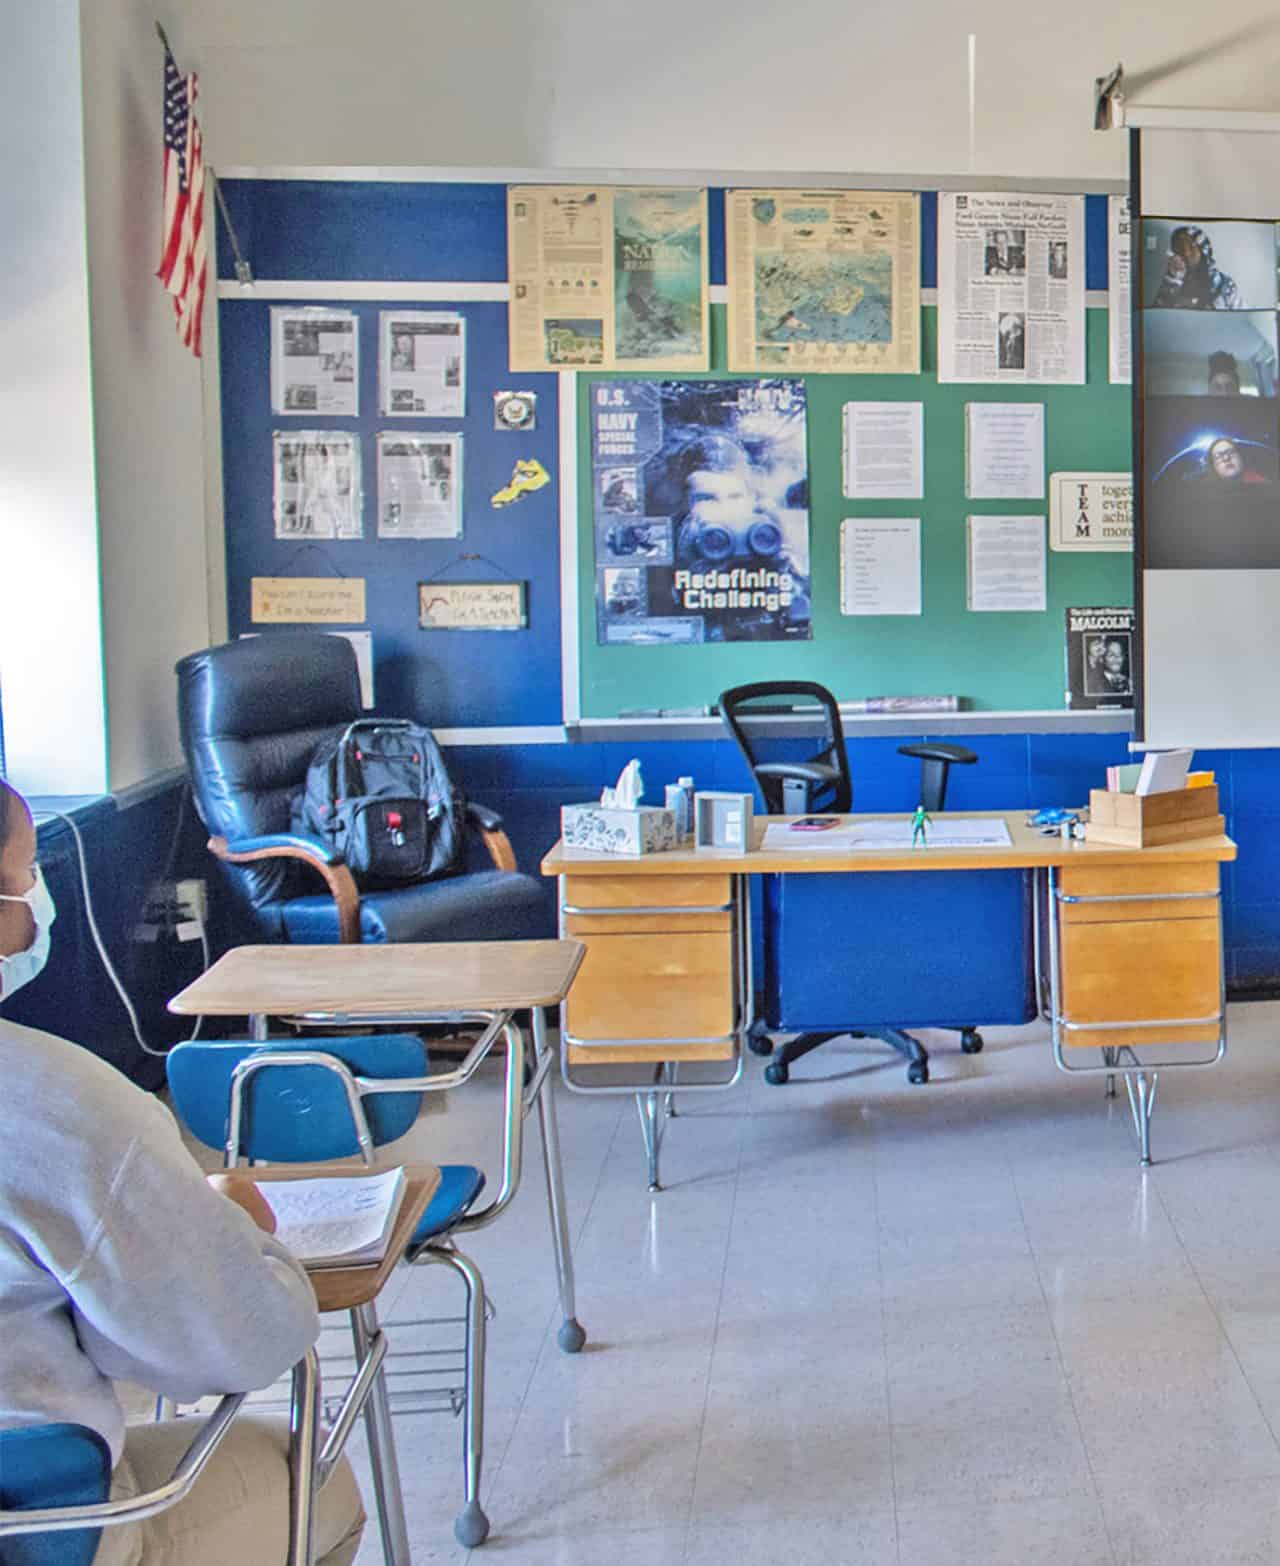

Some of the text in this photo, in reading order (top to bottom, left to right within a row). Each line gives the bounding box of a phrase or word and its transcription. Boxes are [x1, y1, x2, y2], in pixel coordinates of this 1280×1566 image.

[597, 388, 631, 407] U.S.
[597, 412, 639, 431] NAVY
[675, 568, 793, 591] Redefining
[683, 589, 793, 612] Challenge
[1070, 616, 1131, 632] MALCOLM
